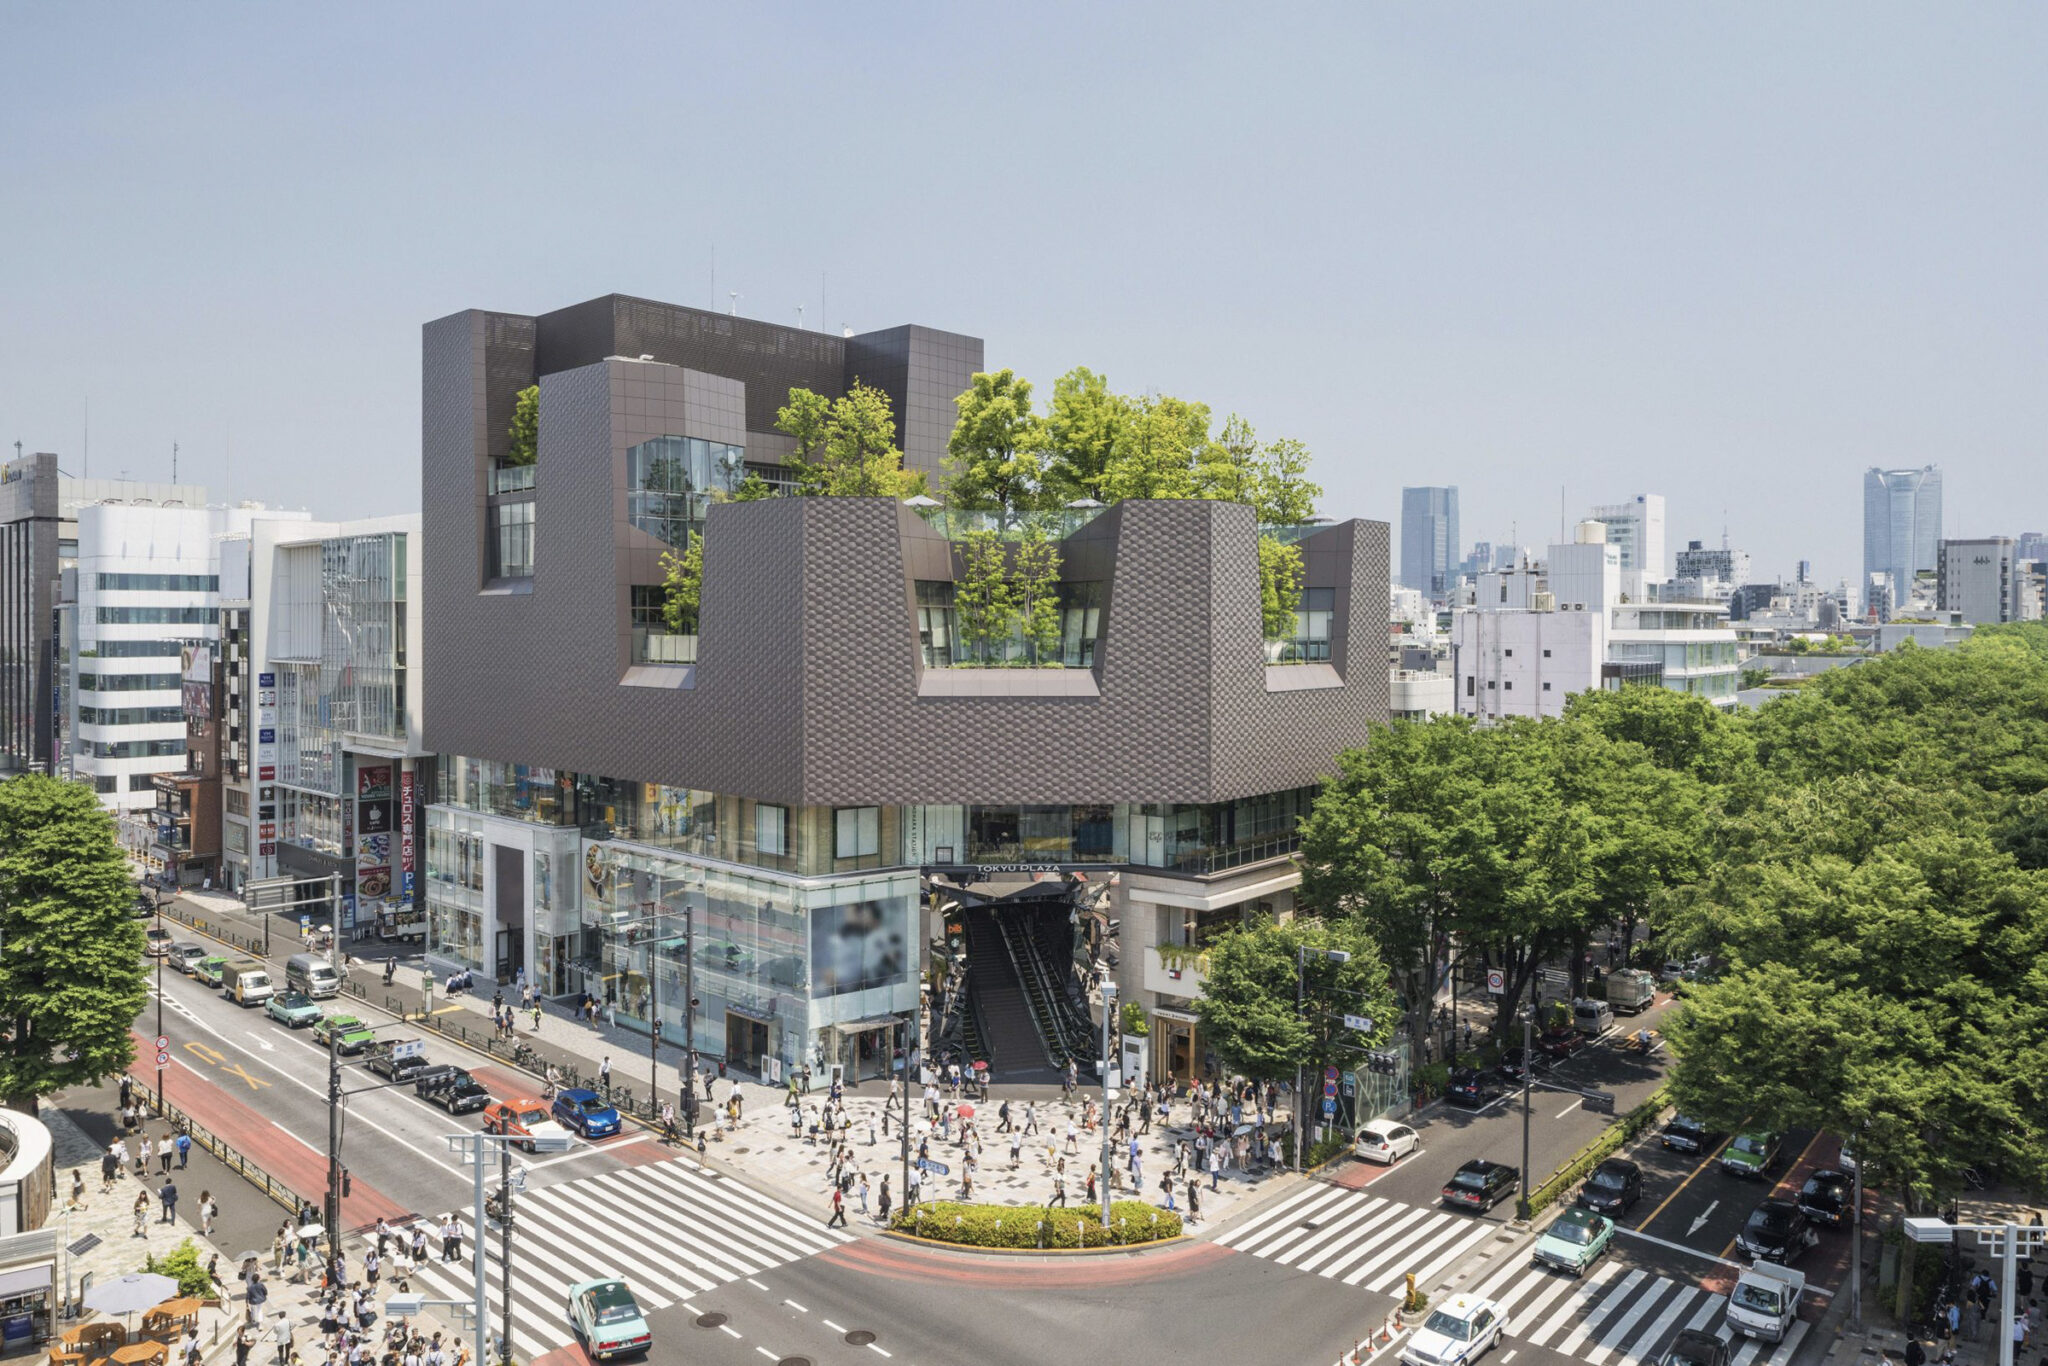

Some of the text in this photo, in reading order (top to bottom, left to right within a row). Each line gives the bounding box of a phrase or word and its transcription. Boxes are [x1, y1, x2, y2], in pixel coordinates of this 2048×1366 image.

[976, 864, 1060, 872] TOKYU PLAZA
[406, 873, 414, 883] P
[948, 923, 962, 934] bills
[1325, 1102, 1332, 1111] P
